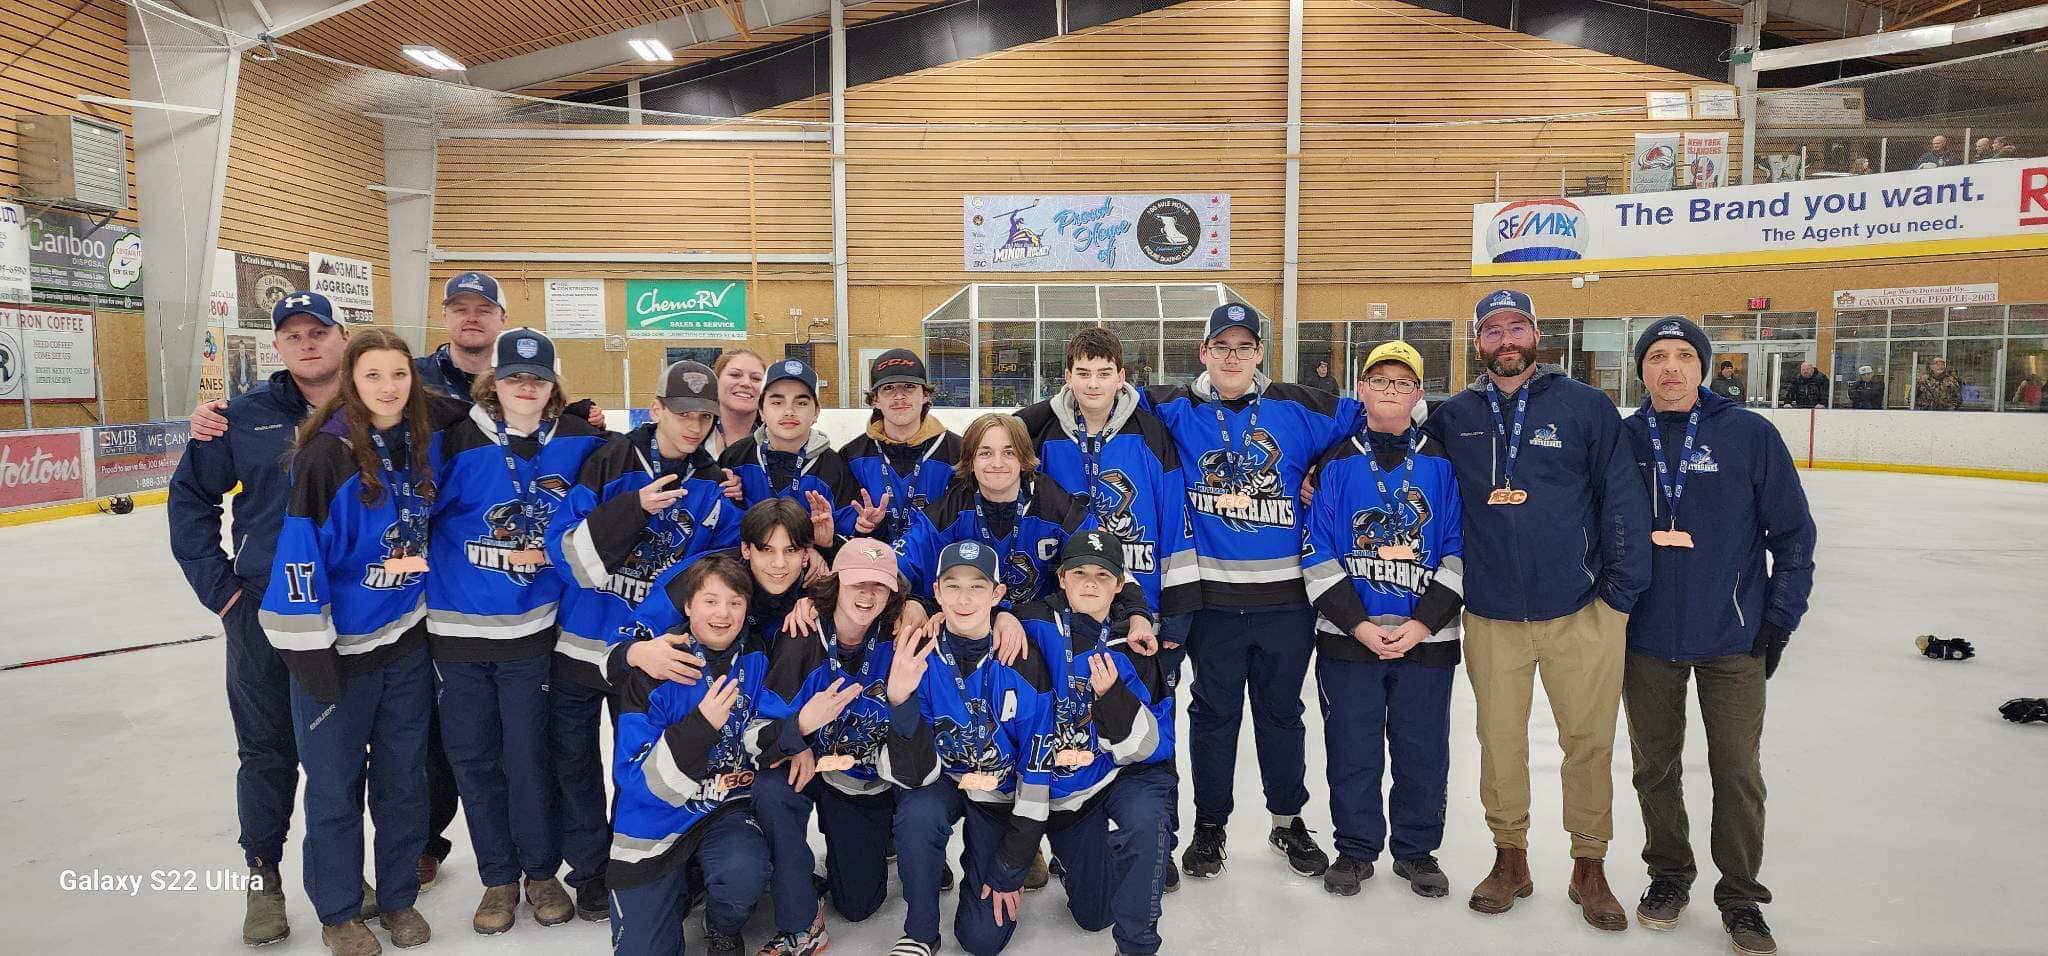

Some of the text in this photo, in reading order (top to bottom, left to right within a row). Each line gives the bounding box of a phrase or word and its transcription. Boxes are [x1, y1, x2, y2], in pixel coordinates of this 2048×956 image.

[1053, 196, 1113, 236] Proud
[1616, 176, 1985, 228] The Brand you want.
[28, 217, 106, 259] Cariboo
[1072, 218, 1131, 251] Home
[1498, 211, 1579, 243] RE/MAX
[1761, 215, 1964, 243] The Agent you need.
[72, 258, 106, 269] DISPOSAL
[993, 247, 1028, 263] MINOR
[1096, 237, 1117, 269] of
[314, 280, 369, 296] AGGREGATES
[1859, 296, 1904, 306] CANADA'S
[1906, 295, 1926, 305] LOG
[16, 312, 42, 329] IRON
[47, 315, 84, 332] COFFEE
[260, 352, 283, 364] RE/MA
[111, 430, 137, 446] MJB
[148, 433, 163, 447] WE
[164, 432, 185, 446] CAN
[101, 464, 118, 474] Proud
[124, 463, 138, 472] serve
[702, 498, 721, 530] A
[1037, 537, 1059, 561] C
[285, 562, 319, 603] 17
[1001, 689, 1018, 722] A
[1025, 733, 1054, 773] 12
